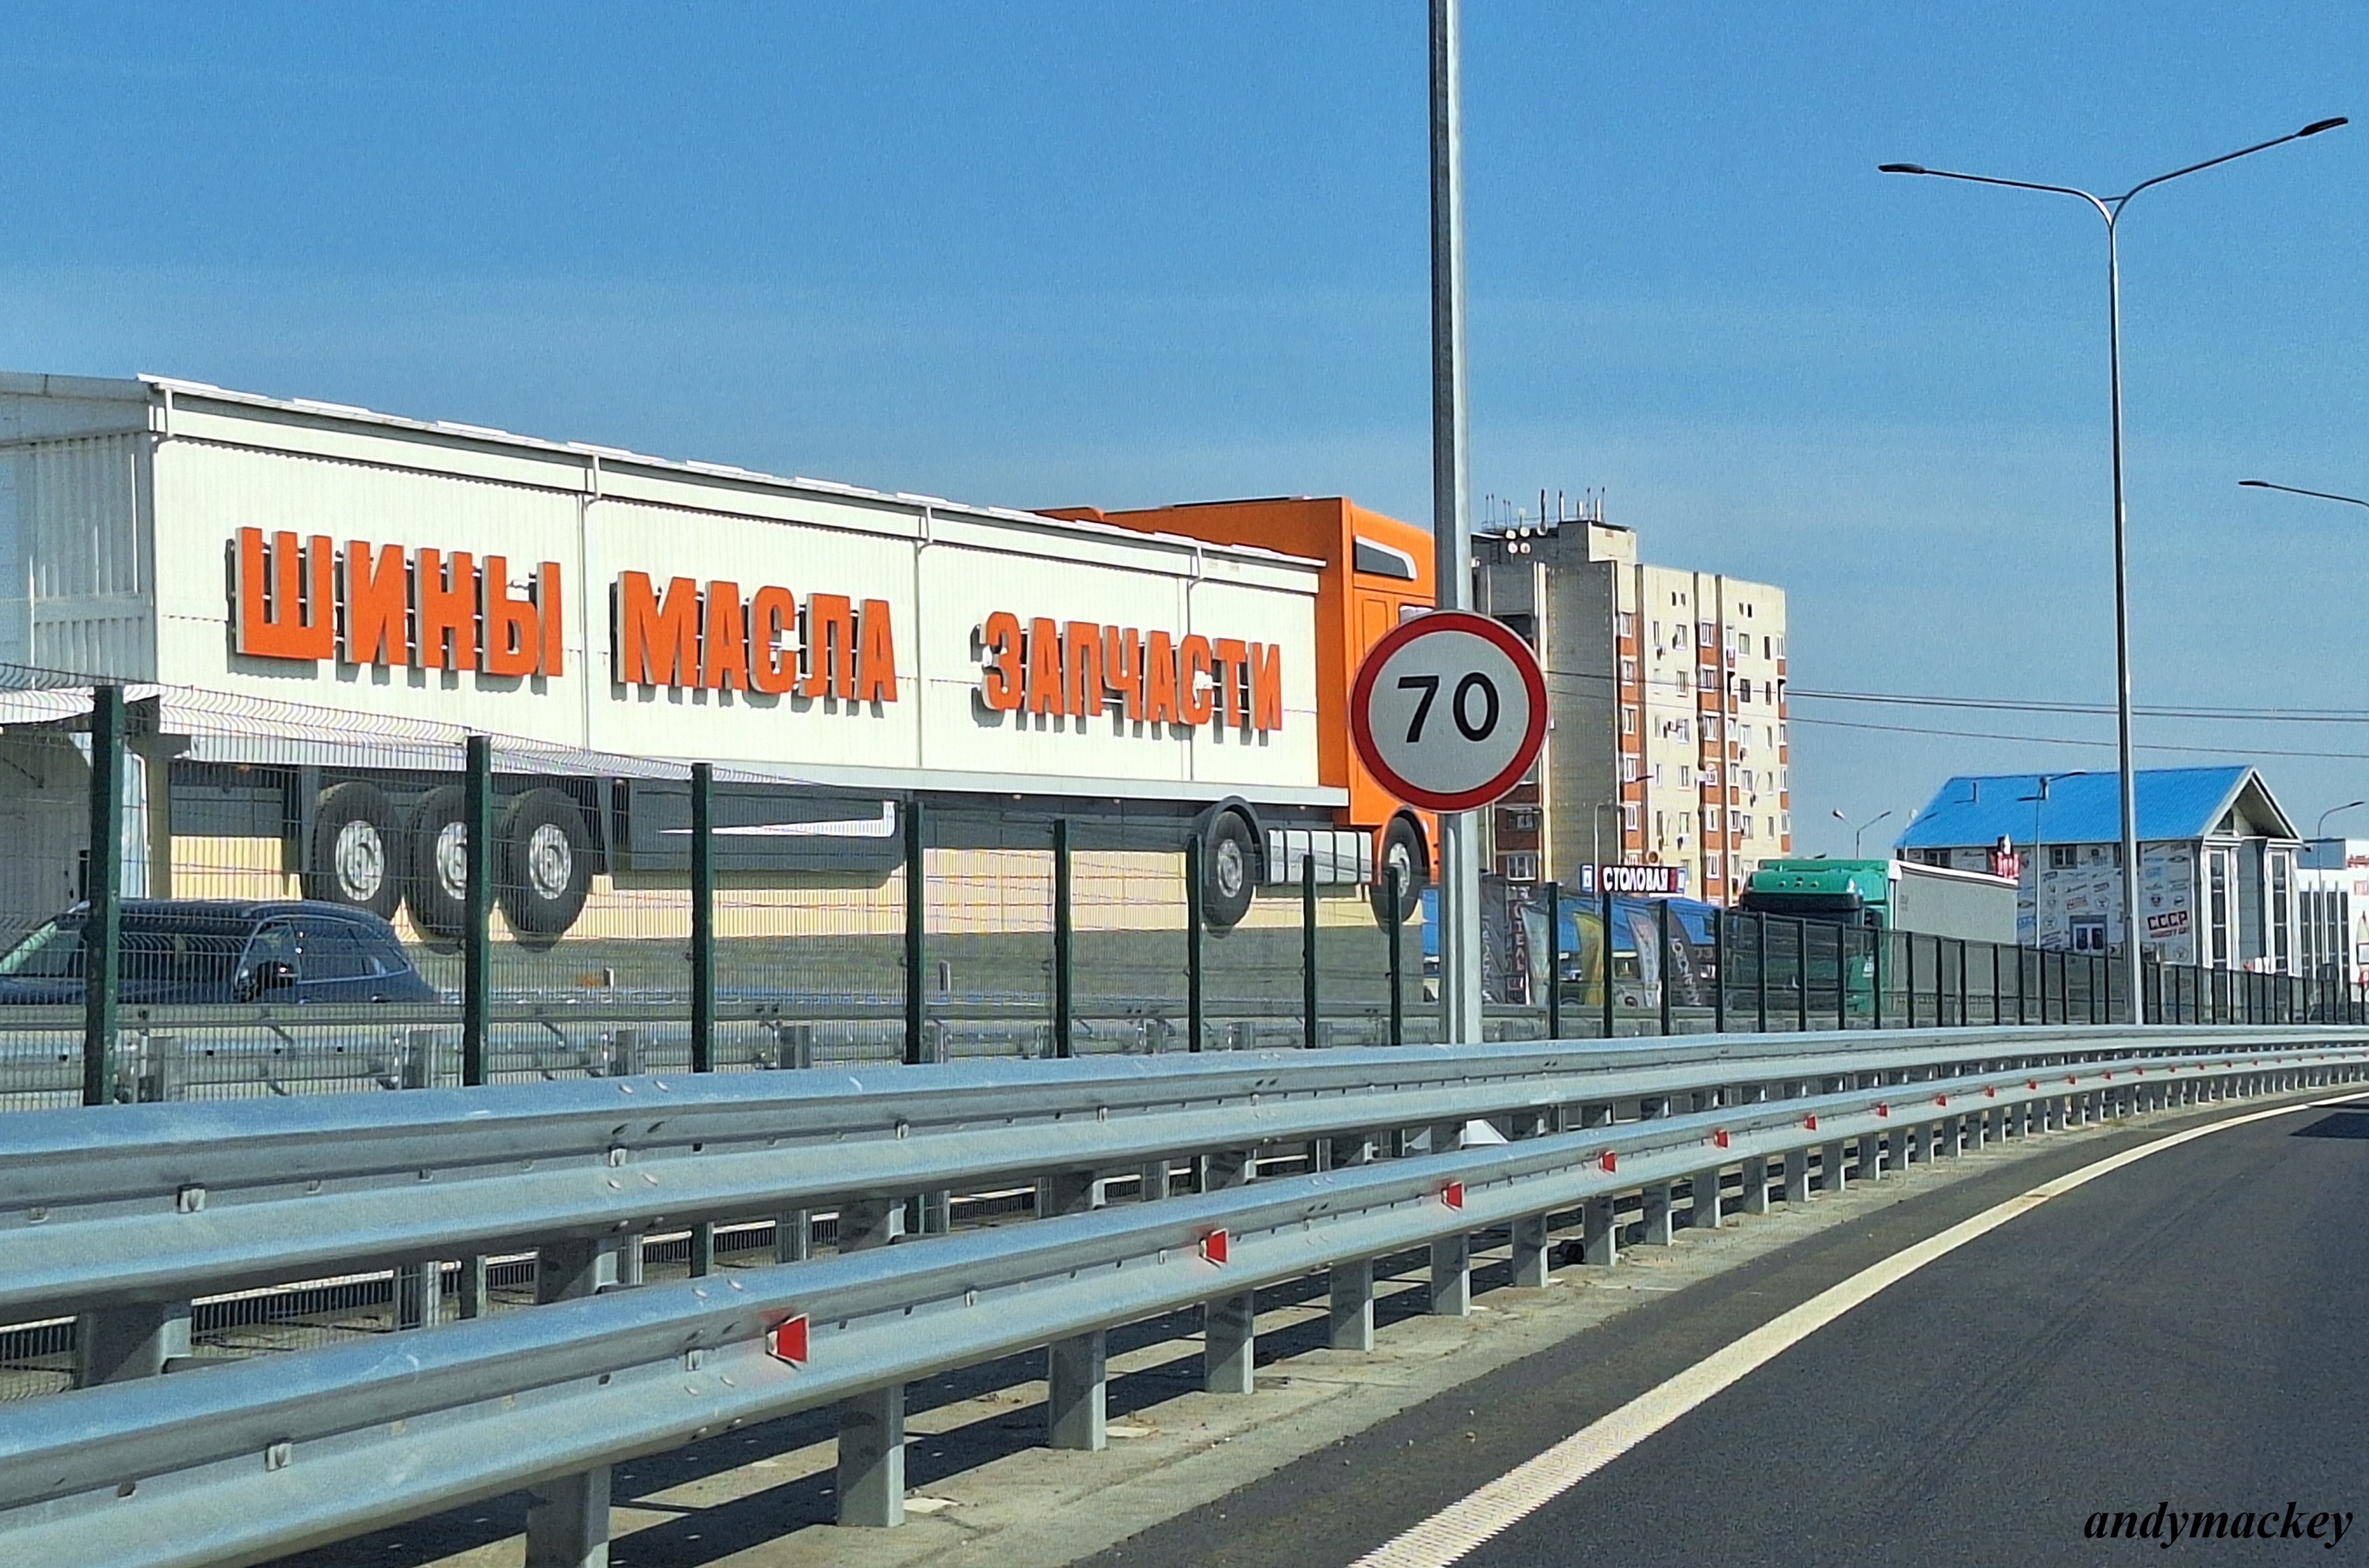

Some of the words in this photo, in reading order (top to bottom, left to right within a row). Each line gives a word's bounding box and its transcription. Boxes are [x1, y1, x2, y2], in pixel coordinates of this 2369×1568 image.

[236, 527, 562, 676] ШИНЫ
[617, 570, 897, 702] МАСЛА
[980, 610, 1283, 731] ЗАПЧАСТИ
[1398, 672, 1499, 742] 70
[1603, 866, 1669, 892] СТОЛОВАЯ
[2147, 910, 2188, 931] СССР
